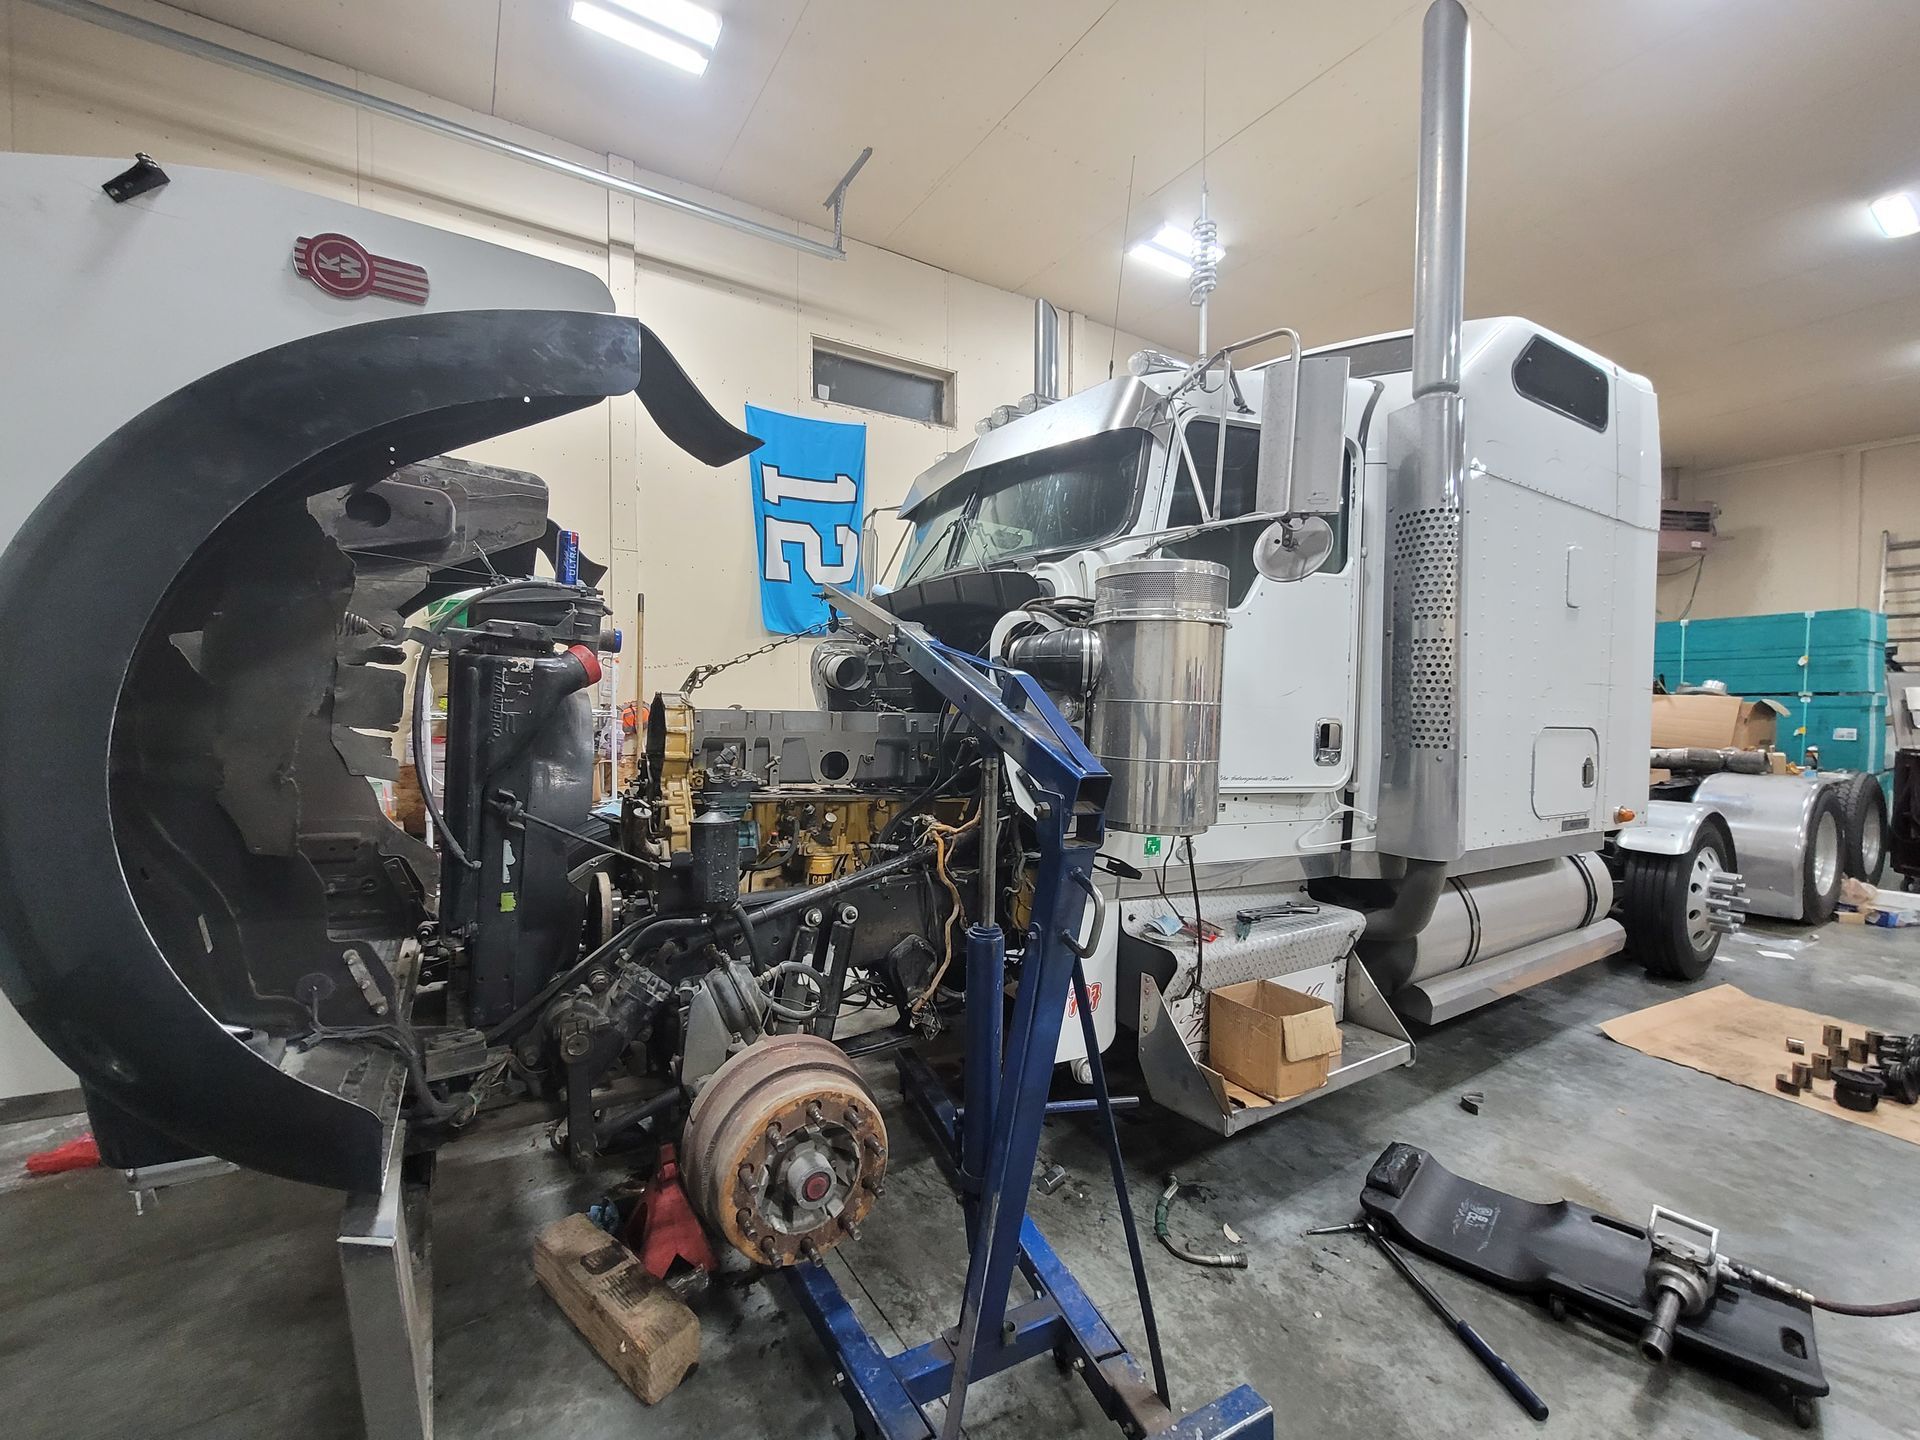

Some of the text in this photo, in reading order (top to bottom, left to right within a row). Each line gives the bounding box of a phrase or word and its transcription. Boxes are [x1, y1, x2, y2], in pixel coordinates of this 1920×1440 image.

[318, 252, 361, 279] KW
[761, 461, 859, 585] 12
[569, 546, 577, 576] ULTRA
[812, 875, 827, 884] CAT
